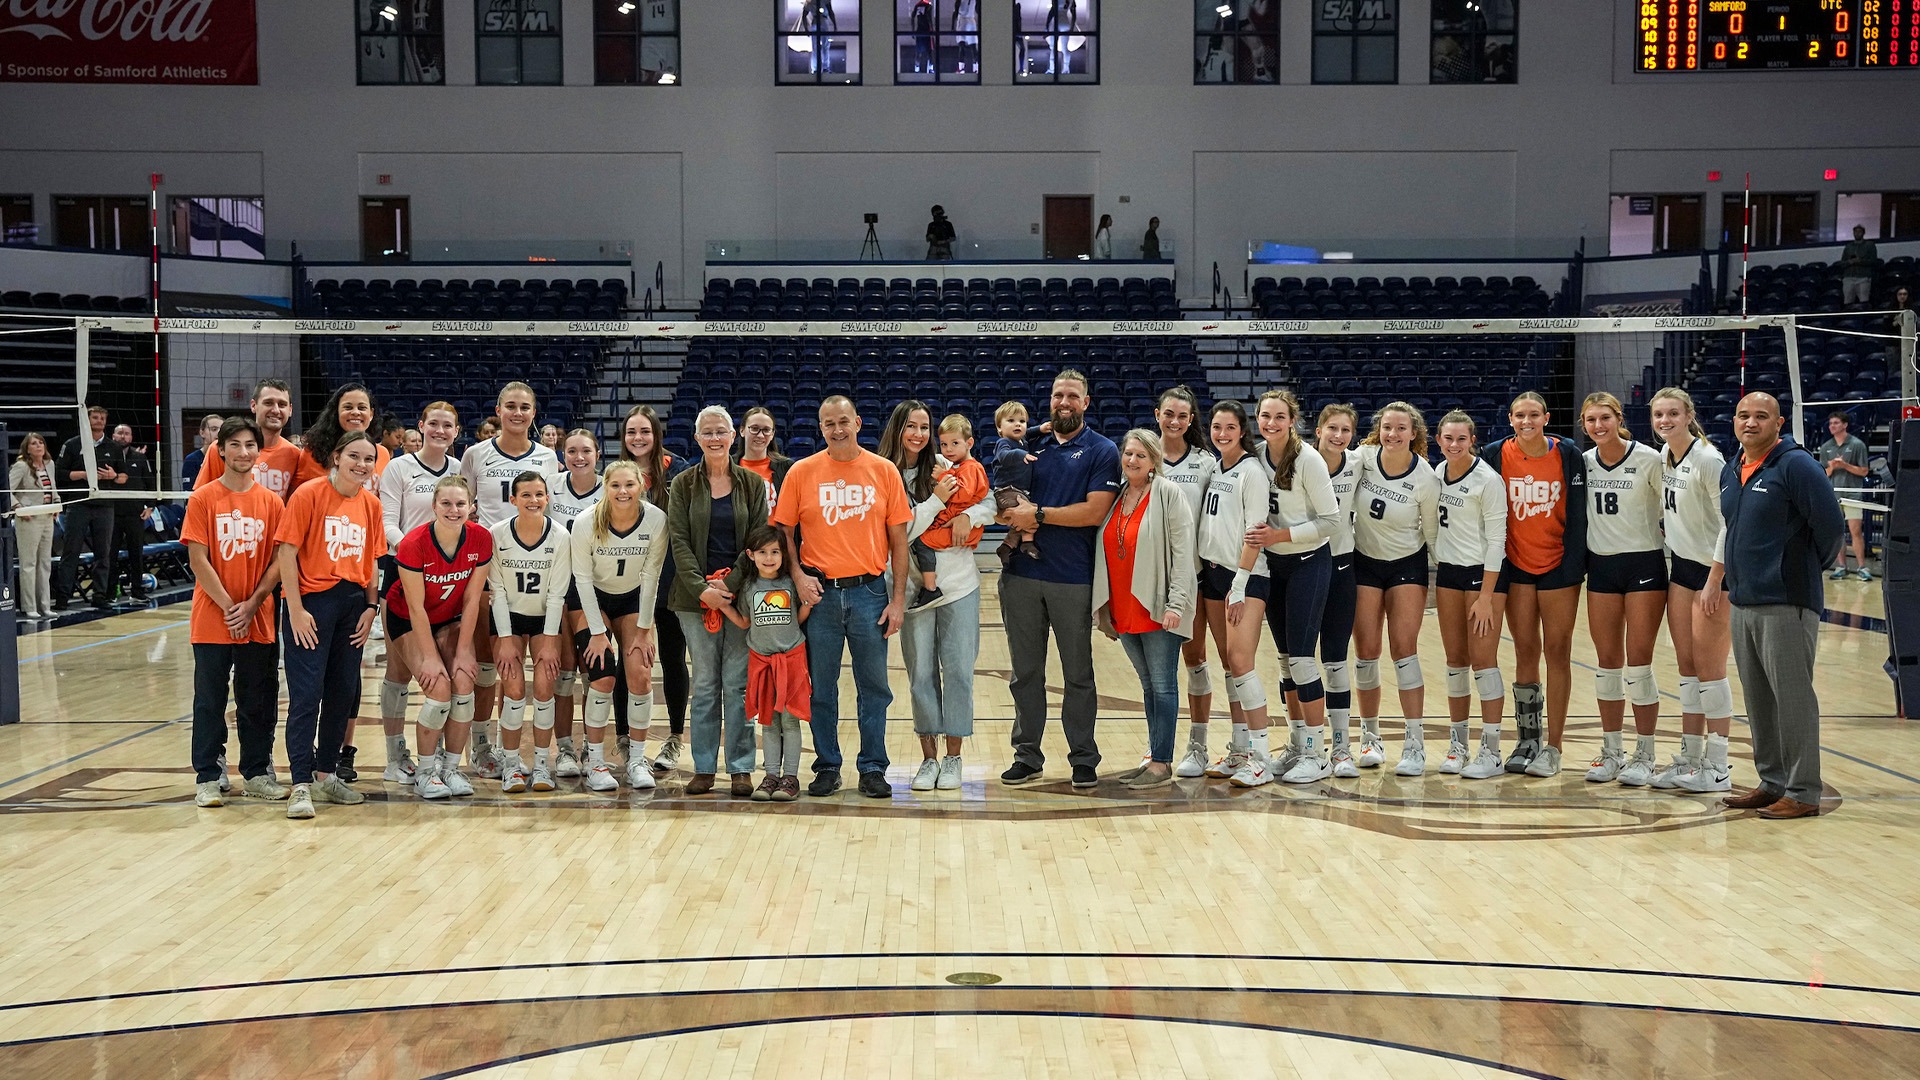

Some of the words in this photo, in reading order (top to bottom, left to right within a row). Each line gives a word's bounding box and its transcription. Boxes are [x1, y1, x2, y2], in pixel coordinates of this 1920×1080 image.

[652, 5, 665, 18] 14
[1322, 0, 1385, 20] SAM
[1641, 4, 1658, 16] 06
[1669, 4, 1677, 16] 0
[1689, 4, 1697, 16] 0
[1709, 1, 1746, 12] SAMFORD
[1820, 0, 1842, 10] UTC
[1864, 0, 1880, 12] 02
[1892, 0, 1900, 12] 0
[1912, 0, 1920, 12] 0
[484, 11, 549, 32] SAM
[1641, 17, 1658, 30] 09
[1669, 18, 1677, 29] 0
[1688, 18, 1696, 29] 0
[1730, 13, 1742, 34] 0
[1779, 16, 1785, 30] 1
[1836, 11, 1848, 32] 0
[1864, 14, 1879, 26] 07
[1892, 13, 1899, 26] 0
[1912, 13, 1920, 25] 0
[1644, 30, 1658, 42] 10
[1668, 30, 1677, 42] 0
[1688, 30, 1696, 42] 0
[1863, 27, 1878, 39] 08
[1891, 27, 1899, 38] 0
[1911, 26, 1919, 38] 0
[1644, 45, 1657, 56] 14
[1668, 44, 1676, 55] 0
[1687, 44, 1696, 55] 0
[1715, 43, 1725, 59] 0
[1737, 42, 1748, 59] 2
[1808, 41, 1819, 58] 2
[1836, 41, 1846, 57] 0
[1866, 41, 1878, 53] 10
[1890, 40, 1898, 52] 0
[1911, 40, 1918, 52] 0
[1644, 57, 1656, 69] 15
[1667, 57, 1676, 69] 0
[1687, 57, 1695, 69] 0
[1866, 54, 1878, 65] 19
[1890, 53, 1897, 65] 0
[1910, 53, 1918, 65] 0
[7, 64, 68, 78] Sponsor
[74, 64, 89, 77] of
[94, 65, 157, 78] Samford
[162, 66, 228, 79] Athletics
[295, 320, 355, 331] SAMFORD
[432, 321, 492, 332] SAMFORD
[569, 321, 629, 332] SAMFORD
[705, 322, 765, 332] SAMFORD
[841, 322, 901, 332] SAMFORD
[977, 322, 1037, 332] SAMFORD
[1113, 322, 1173, 332] SAMFORD
[1249, 321, 1308, 332] SAMFORD
[1384, 320, 1444, 331] SAMFORD
[1519, 319, 1579, 330] SAMFORD
[1655, 318, 1715, 328] SAMFORD
[1361, 478, 1408, 504] SAMFORD
[1206, 492, 1219, 516] 10
[1595, 492, 1618, 515] 18
[1665, 488, 1677, 513] 14
[552, 503, 584, 516] SAMF
[822, 502, 871, 526] Orange
[1369, 498, 1386, 520] 9
[1439, 505, 1449, 528] 2
[596, 546, 648, 556] SAMFORD
[502, 559, 552, 569] SAMFORD
[616, 559, 626, 577] 1
[515, 572, 540, 594] 12
[440, 584, 456, 600] 7
[756, 616, 790, 624] COLORADO
